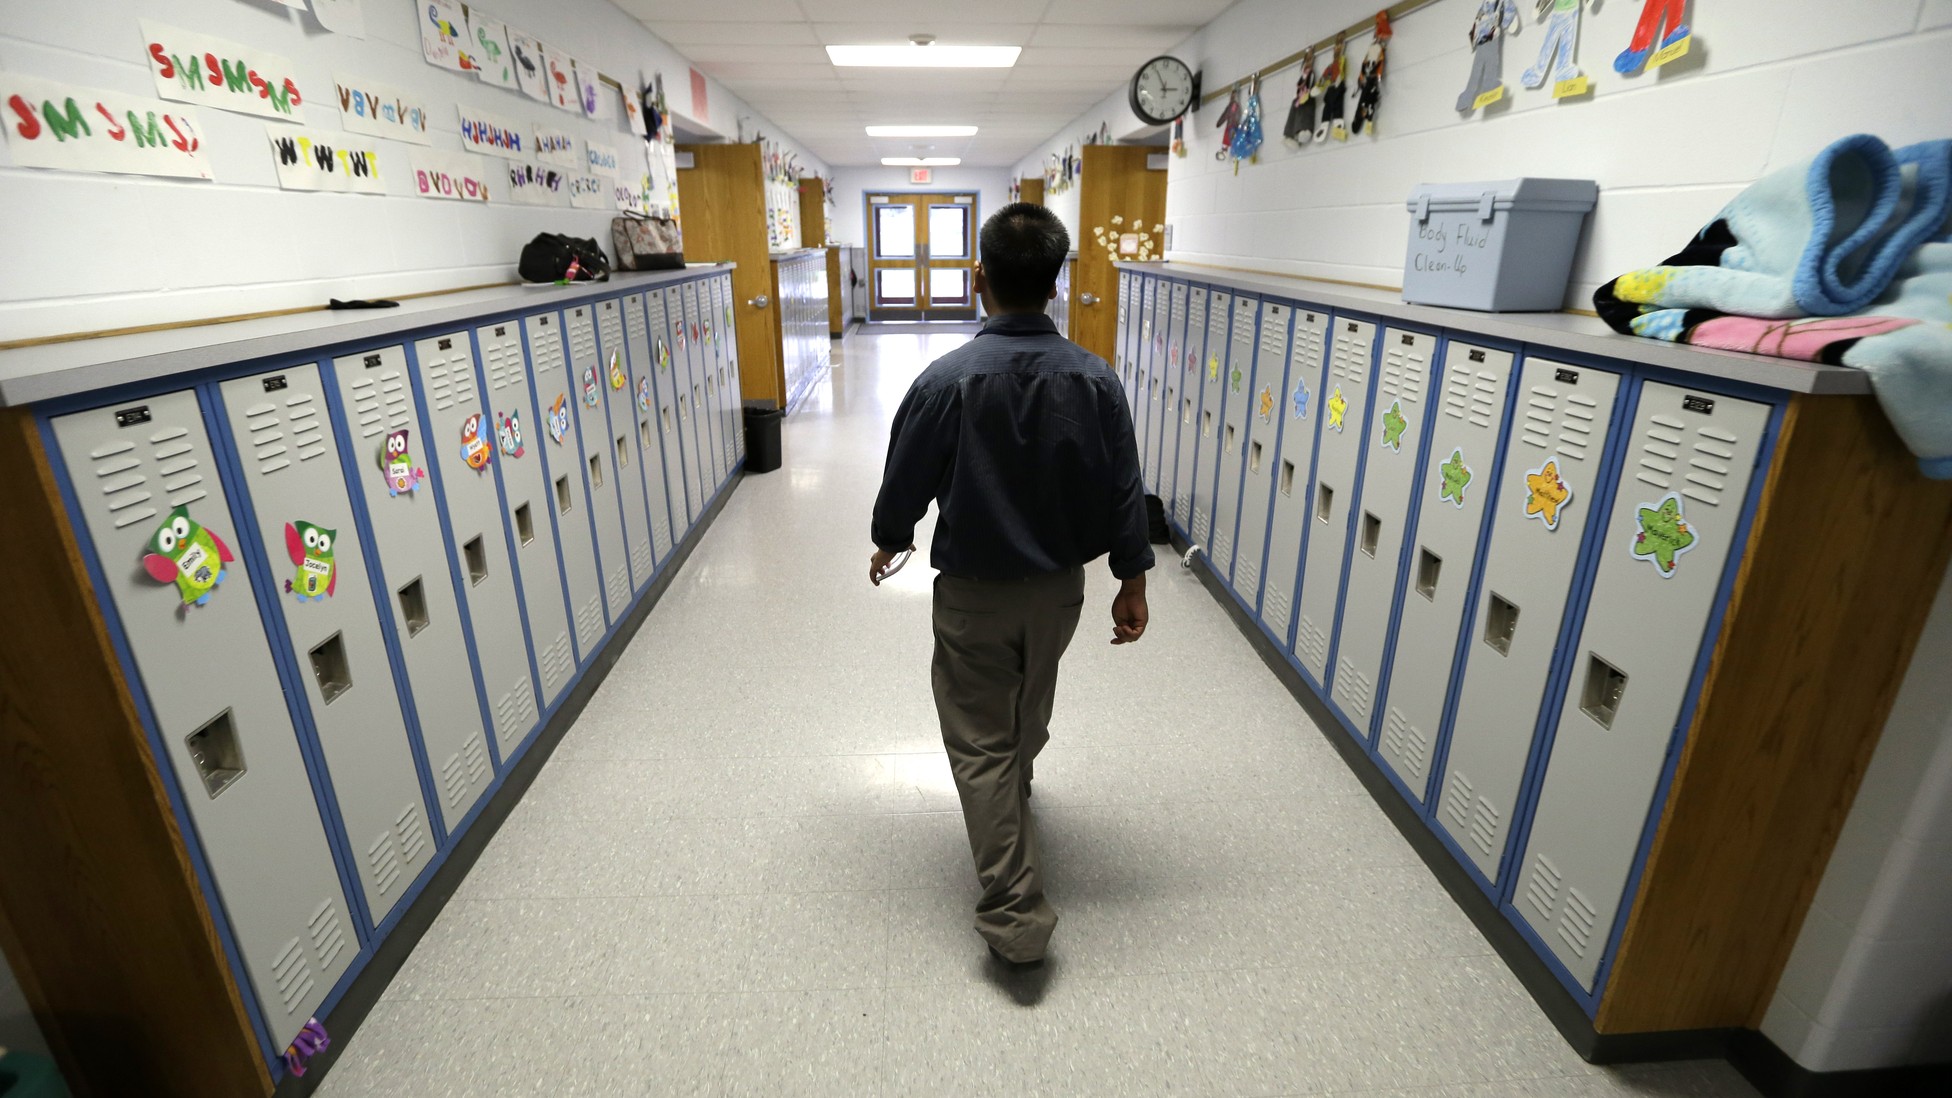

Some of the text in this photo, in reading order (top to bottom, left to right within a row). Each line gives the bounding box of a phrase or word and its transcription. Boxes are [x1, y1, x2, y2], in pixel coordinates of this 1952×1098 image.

[461, 117, 521, 152] HJHJHJH
[275, 136, 378, 179] WTWTWT
[1456, 223, 1489, 249] Fluid
[305, 559, 327, 573] Jocelyn
